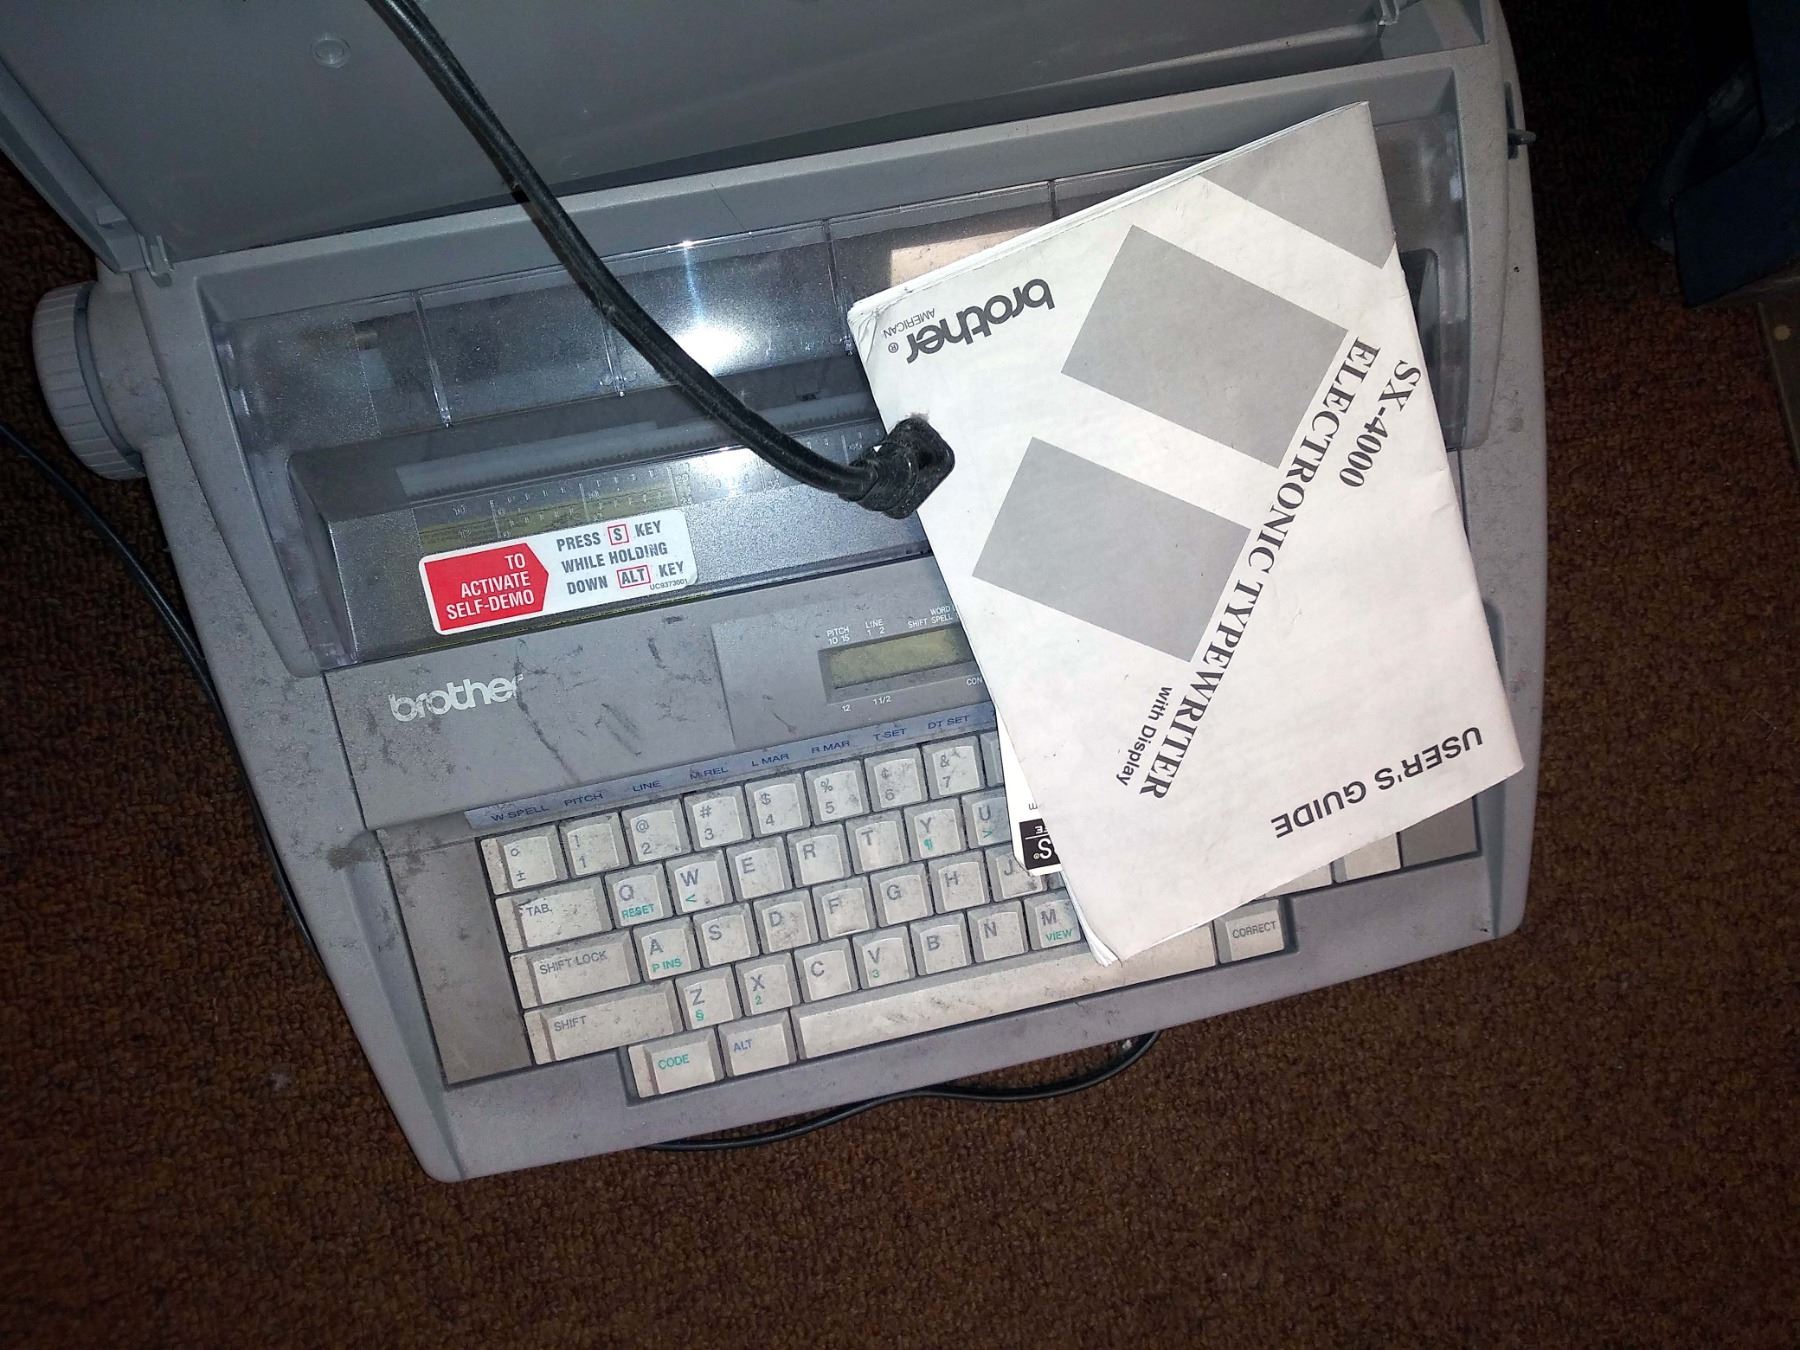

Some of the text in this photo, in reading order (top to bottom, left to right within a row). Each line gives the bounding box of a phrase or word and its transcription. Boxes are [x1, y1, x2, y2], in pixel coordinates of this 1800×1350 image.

[883, 307, 935, 339] AMERICAN
[906, 278, 1055, 364] brother
[1338, 359, 1424, 489] SX-4000
[1246, 336, 1382, 575] ELECTRONIC
[556, 531, 601, 552] PRESS
[635, 520, 661, 537] KEY
[505, 552, 526, 569] TO
[561, 542, 668, 574] WHILE HOLDING
[460, 570, 531, 599] ACTIVATE
[566, 560, 684, 596] DOWN ALT KEY
[446, 589, 535, 620] SELF-DEMO
[930, 605, 951, 616] WORD
[864, 619, 885, 629] LINE
[907, 614, 953, 629] SHIFT SPELL
[826, 626, 850, 638] PITCH
[388, 673, 524, 722] brother
[1139, 580, 1265, 800] TYPEWRITER
[946, 714, 970, 726] SET
[1115, 685, 1173, 787] with Display
[824, 740, 851, 752] MAR
[761, 753, 790, 765] MAR
[632, 780, 662, 792] LINE
[1271, 726, 1483, 839] USER'S GUIDE
[563, 792, 604, 807] PITCH
[824, 801, 835, 814] 5
[507, 804, 550, 819] SPELL
[765, 813, 776, 826] 4
[978, 804, 992, 821] U
[920, 817, 932, 833] Y
[704, 828, 715, 841] 3
[861, 830, 873, 846] T
[641, 842, 651, 855] 2
[802, 843, 817, 860] R
[742, 856, 756, 874] E
[1004, 859, 1014, 876] J
[680, 868, 699, 887] W
[944, 871, 959, 888] H
[619, 884, 634, 901] Q
[886, 885, 901, 901] G
[526, 903, 549, 917] TAB
[621, 903, 654, 919] RESET
[827, 897, 840, 914] F
[769, 911, 783, 928] D
[1041, 909, 1057, 926] M
[709, 924, 722, 941] S
[983, 921, 998, 939] N
[1045, 928, 1073, 942] VIEW
[1232, 919, 1277, 940] CORRECT
[650, 939, 664, 955] A
[926, 935, 941, 951] B
[539, 950, 609, 975] SHIFT LOCK
[868, 947, 881, 964] V
[811, 961, 825, 977] C
[750, 974, 765, 991] X
[689, 988, 705, 1006] Z
[553, 1015, 587, 1032] SHIFT
[733, 1038, 753, 1053] ALT
[657, 1053, 690, 1070] CODE
